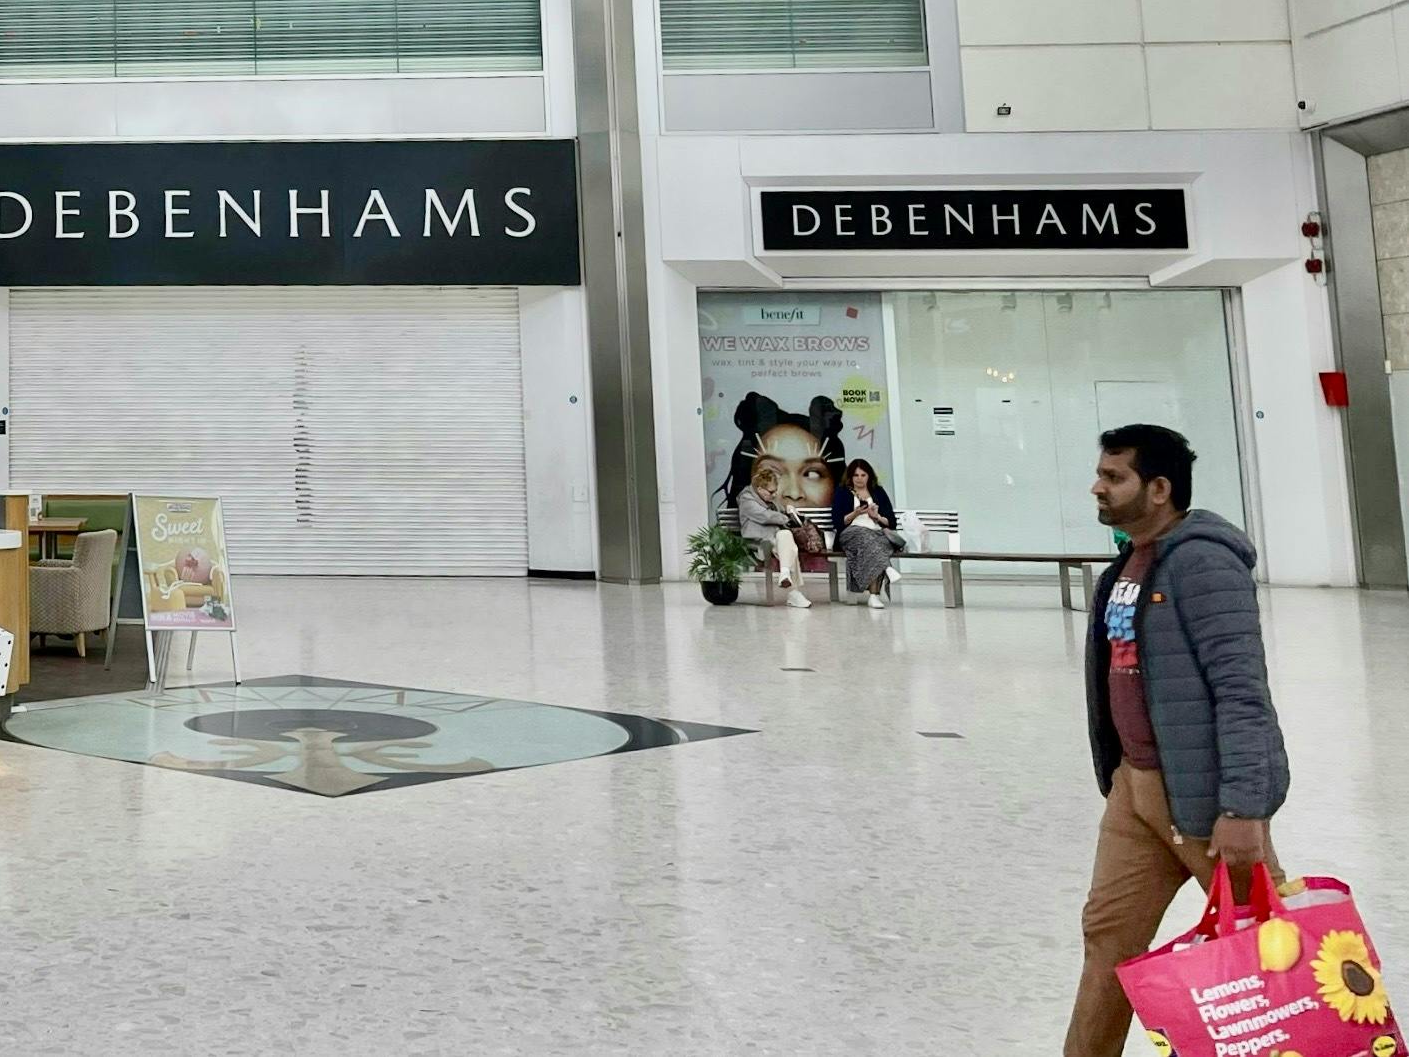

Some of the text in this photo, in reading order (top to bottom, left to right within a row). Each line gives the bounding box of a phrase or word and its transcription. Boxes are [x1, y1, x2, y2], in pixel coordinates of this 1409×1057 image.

[791, 202, 1158, 236] DEBENHAMS
[760, 307, 805, 322] benefit
[702, 336, 871, 352] WE WAX BROWS
[738, 358, 755, 367] tint
[769, 358, 793, 369] style
[797, 360, 820, 369] your
[823, 360, 843, 369] way
[751, 369, 823, 380] perfect brows
[151, 512, 204, 542] Sweet
[1191, 975, 1266, 1005] Lemons,
[1198, 994, 1271, 1024] Flowers,
[1206, 995, 1320, 1041] Lawnmowers,
[1214, 1028, 1291, 1057] Peppers.
